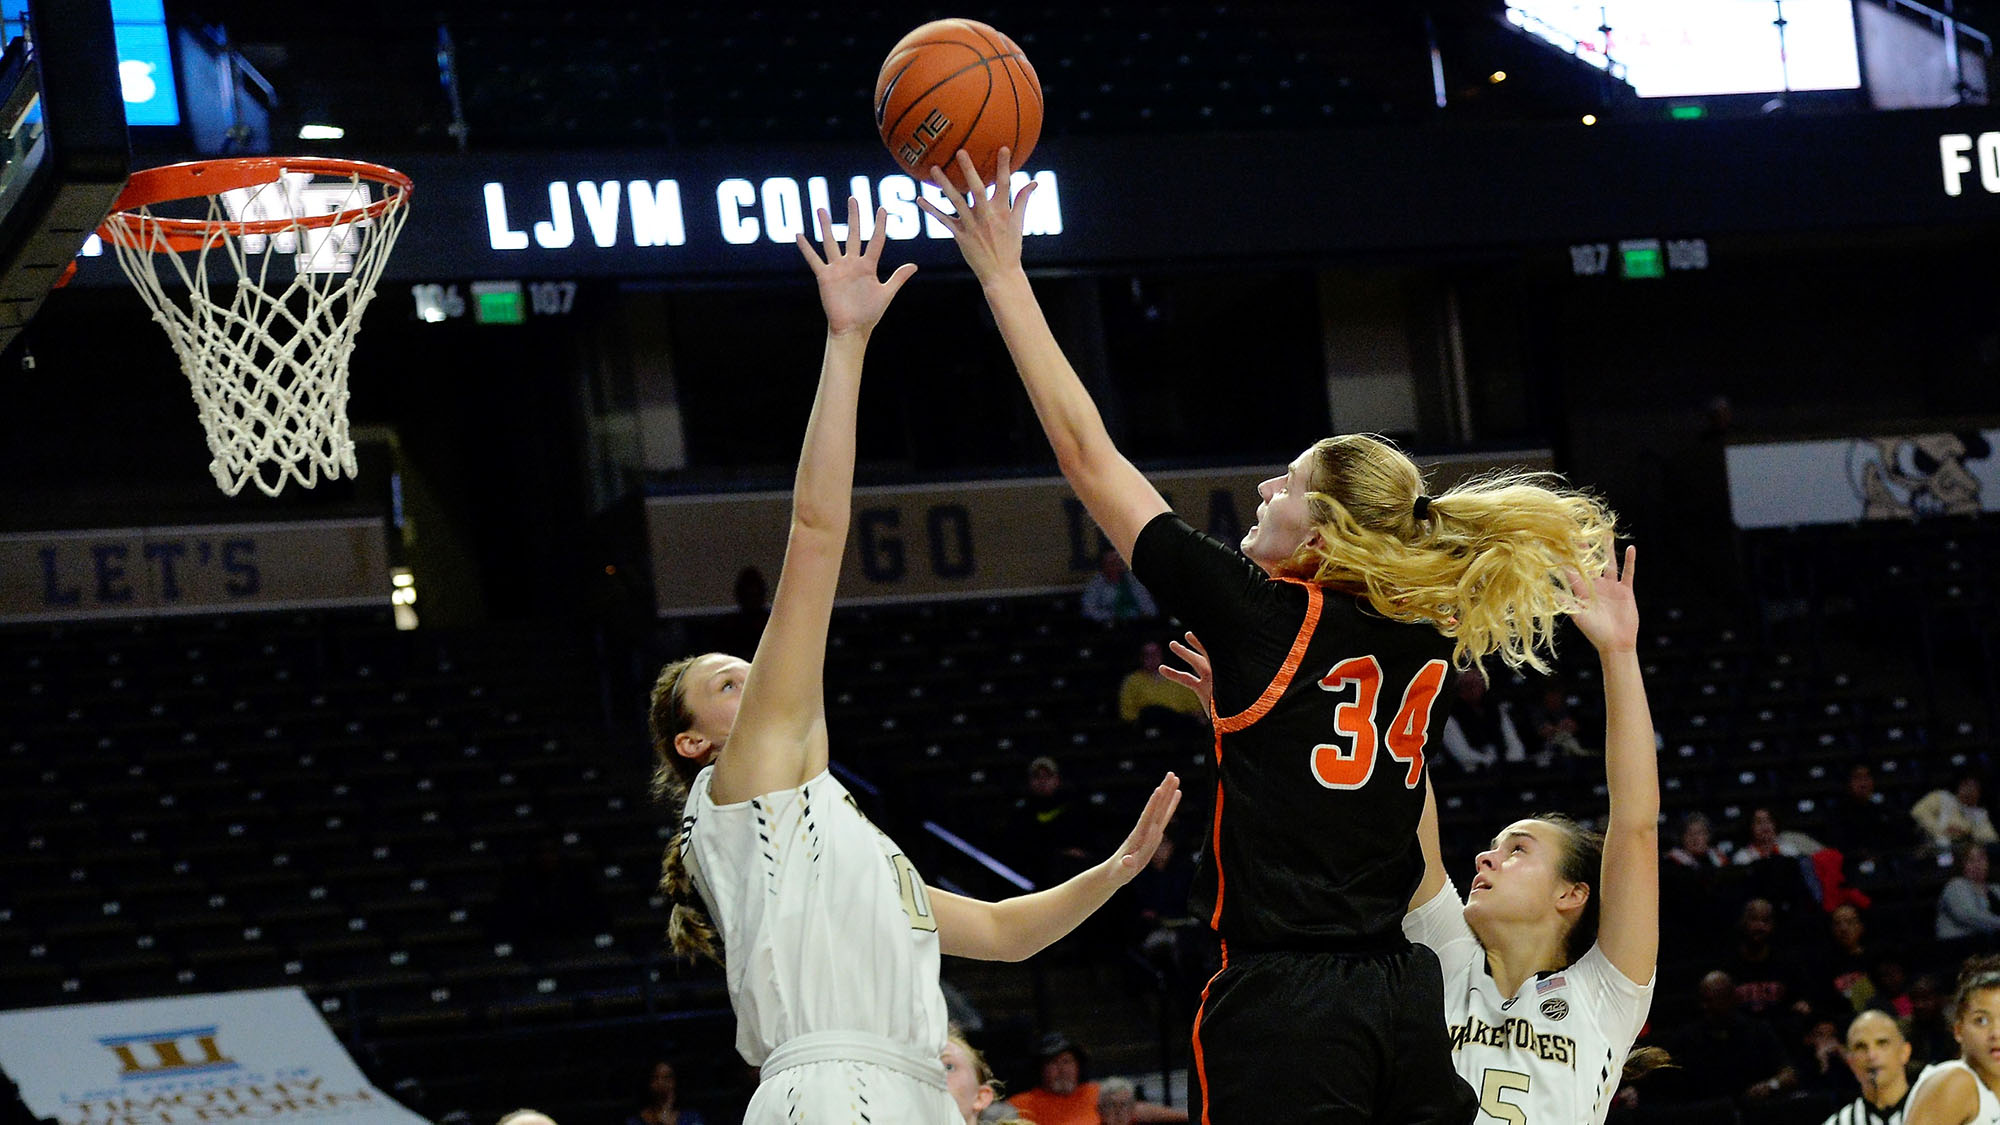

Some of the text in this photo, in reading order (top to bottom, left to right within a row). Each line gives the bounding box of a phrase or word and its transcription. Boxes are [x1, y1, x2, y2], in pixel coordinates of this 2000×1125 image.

[483, 178, 687, 250] LJVM
[38, 539, 261, 607] LET'S
[858, 503, 975, 584] GO
[1310, 654, 1448, 790] 34
[1479, 1068, 1531, 1125] 5
